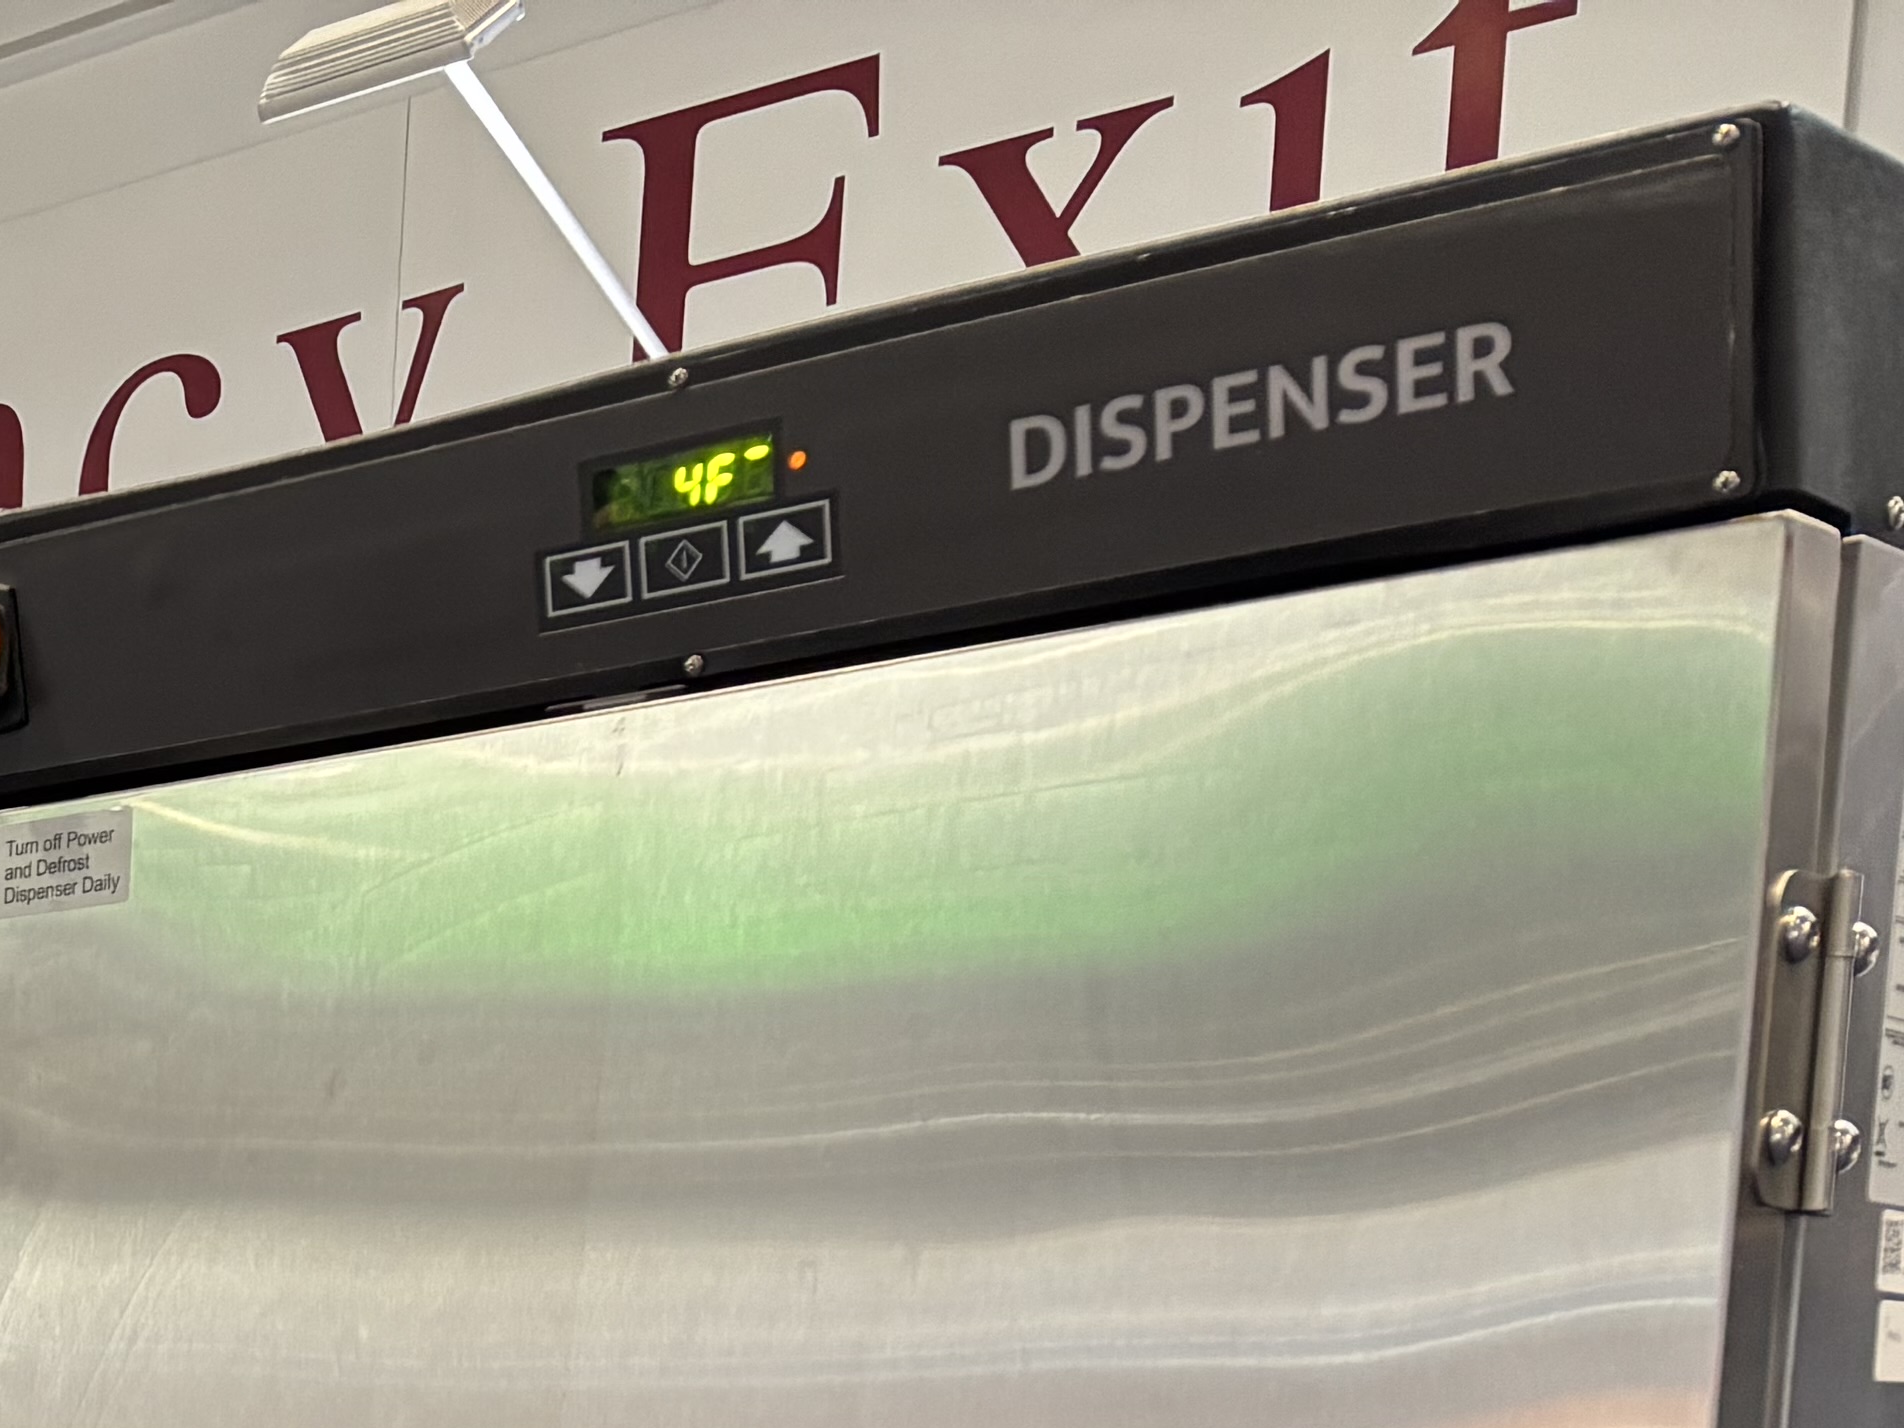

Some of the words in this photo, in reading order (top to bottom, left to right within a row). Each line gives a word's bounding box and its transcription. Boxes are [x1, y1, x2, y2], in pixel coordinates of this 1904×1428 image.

[1009, 321, 1515, 491] DISPENSER
[6, 839, 39, 857] Turn
[43, 832, 64, 853] off
[67, 828, 115, 849] Power
[4, 863, 32, 881] and
[36, 853, 90, 877] Defrost
[4, 880, 78, 905] Dispenser
[82, 873, 121, 895] Daily
